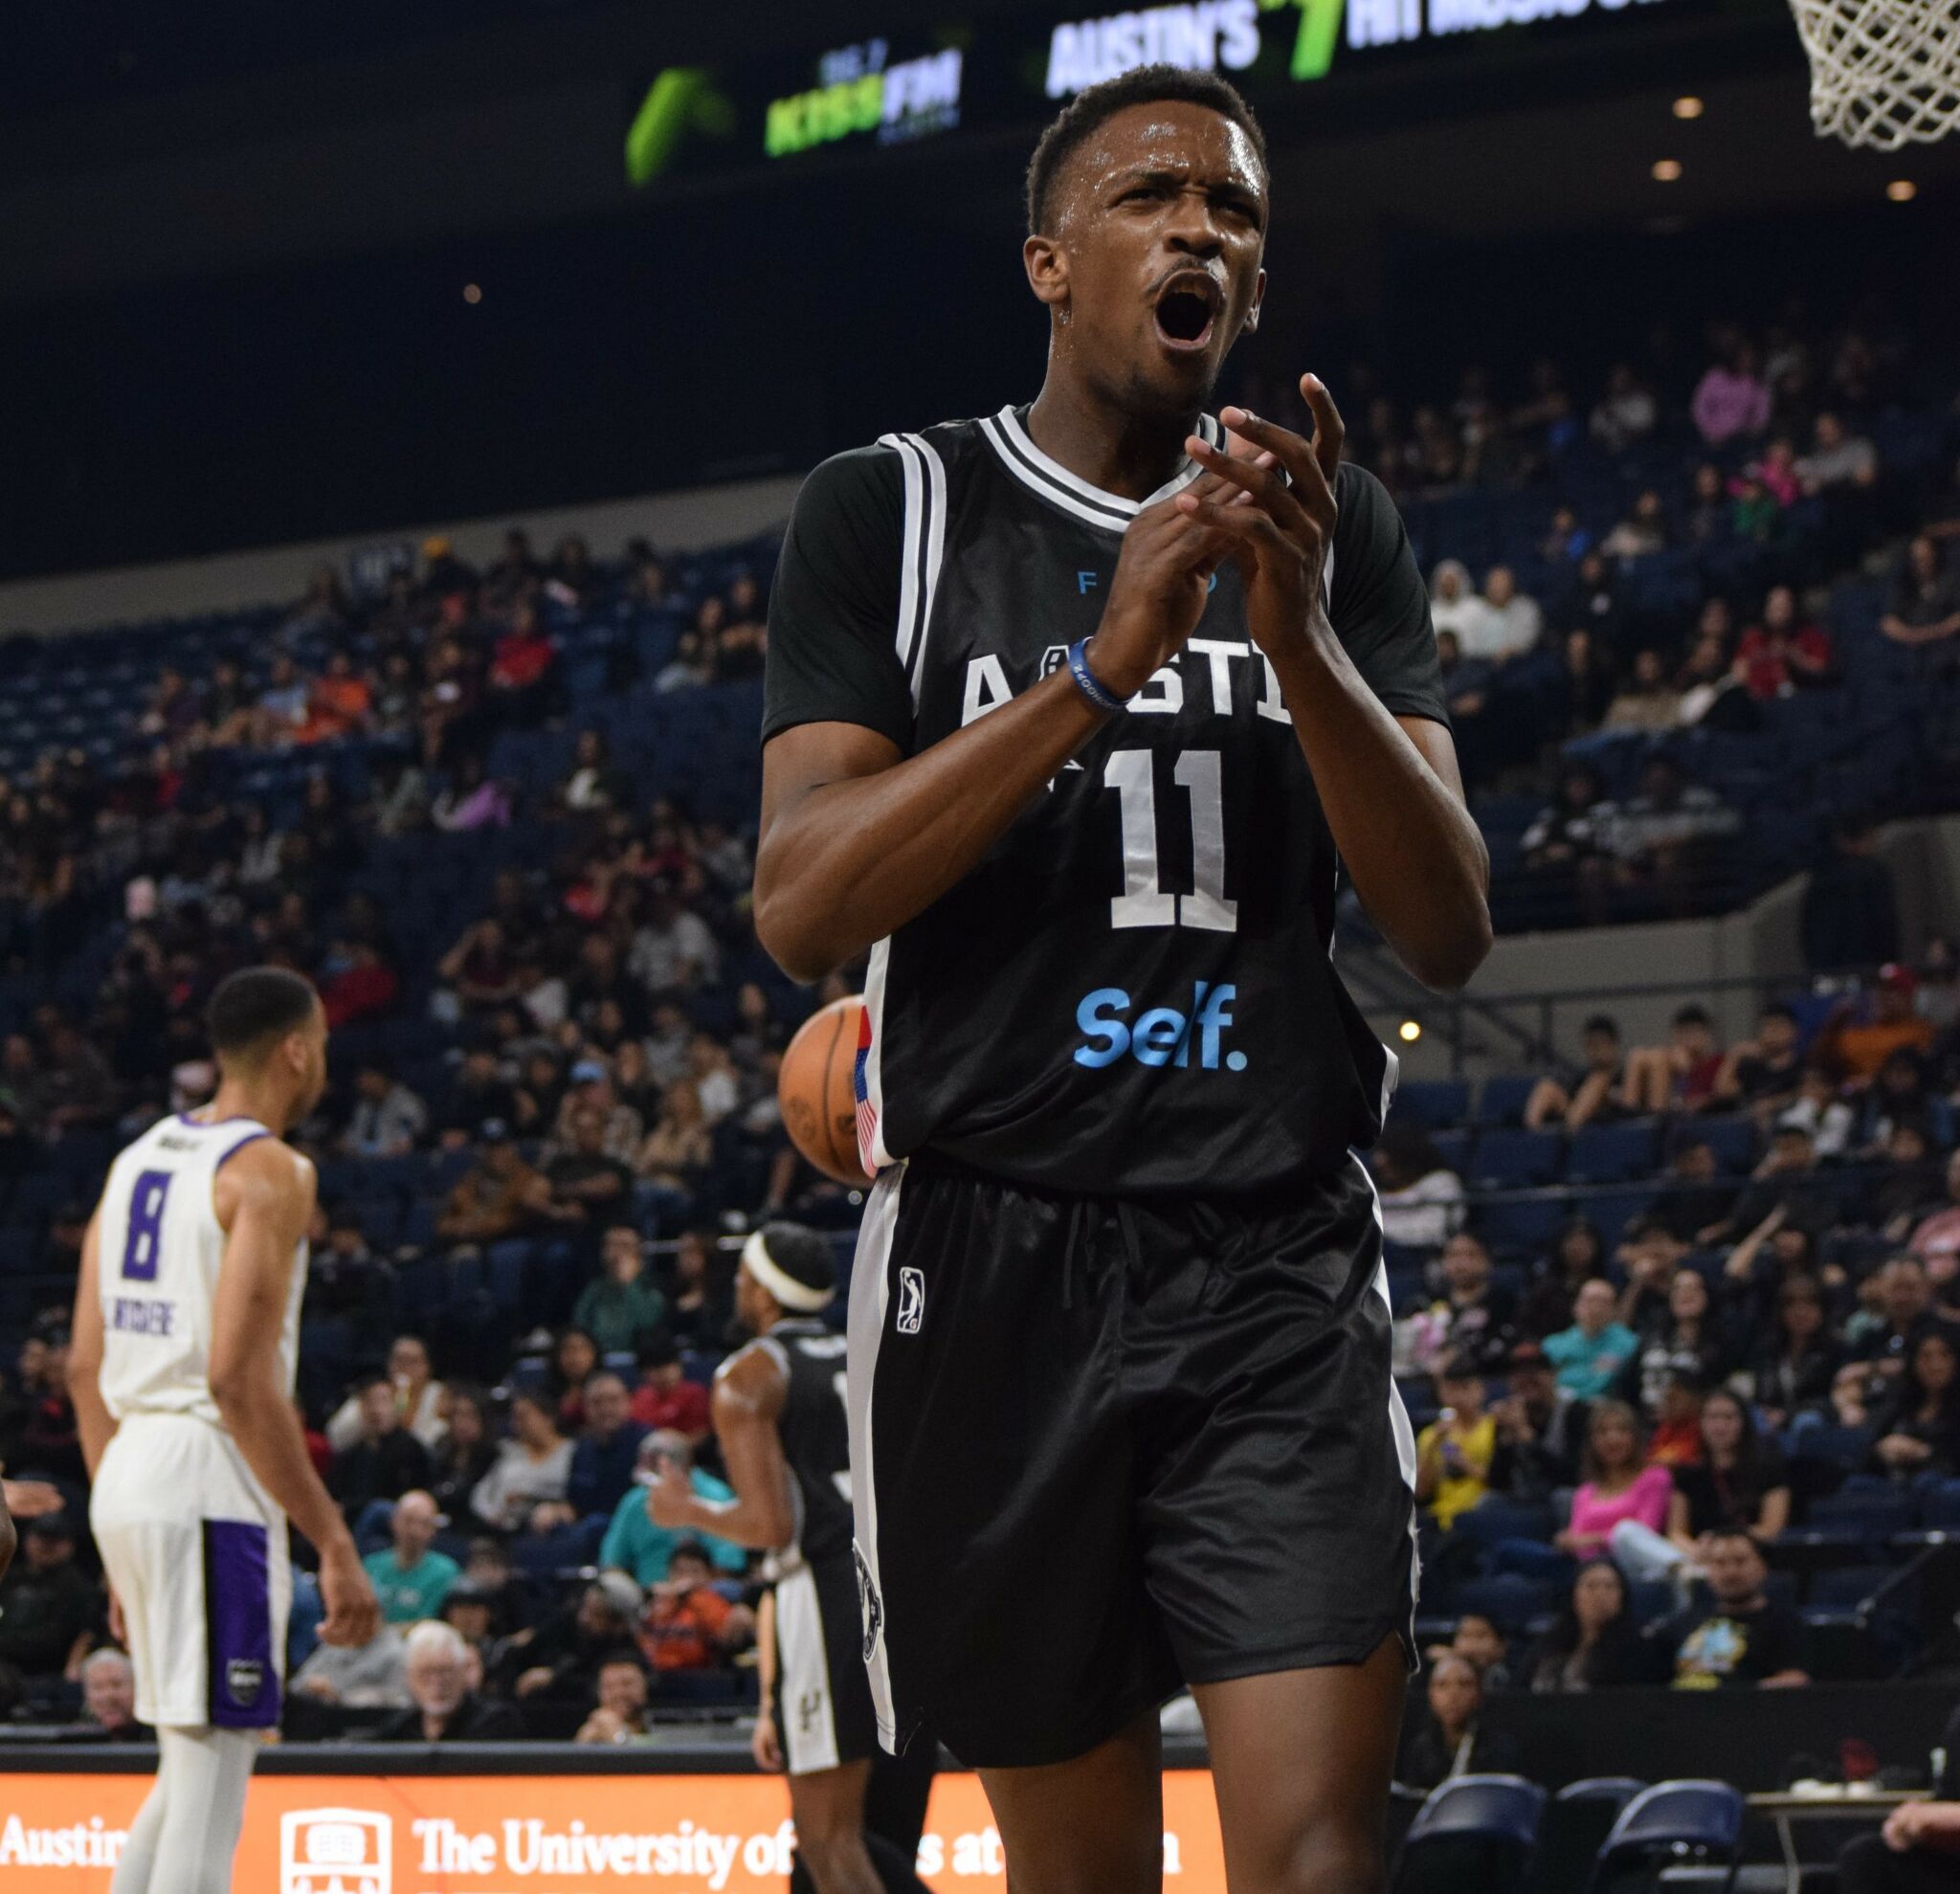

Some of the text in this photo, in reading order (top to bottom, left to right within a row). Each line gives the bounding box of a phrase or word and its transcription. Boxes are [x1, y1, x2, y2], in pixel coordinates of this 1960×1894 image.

[1046, 0, 1260, 99] AUSTIN'S
[961, 637, 1293, 727] ASTI
[1103, 748, 1238, 932] 11
[1073, 979, 1248, 1071] Self.
[121, 1168, 174, 1283] 8
[412, 1817, 498, 1876] The
[501, 1817, 741, 1891] University
[743, 1817, 798, 1877] of
[951, 1825, 1006, 1876] at
